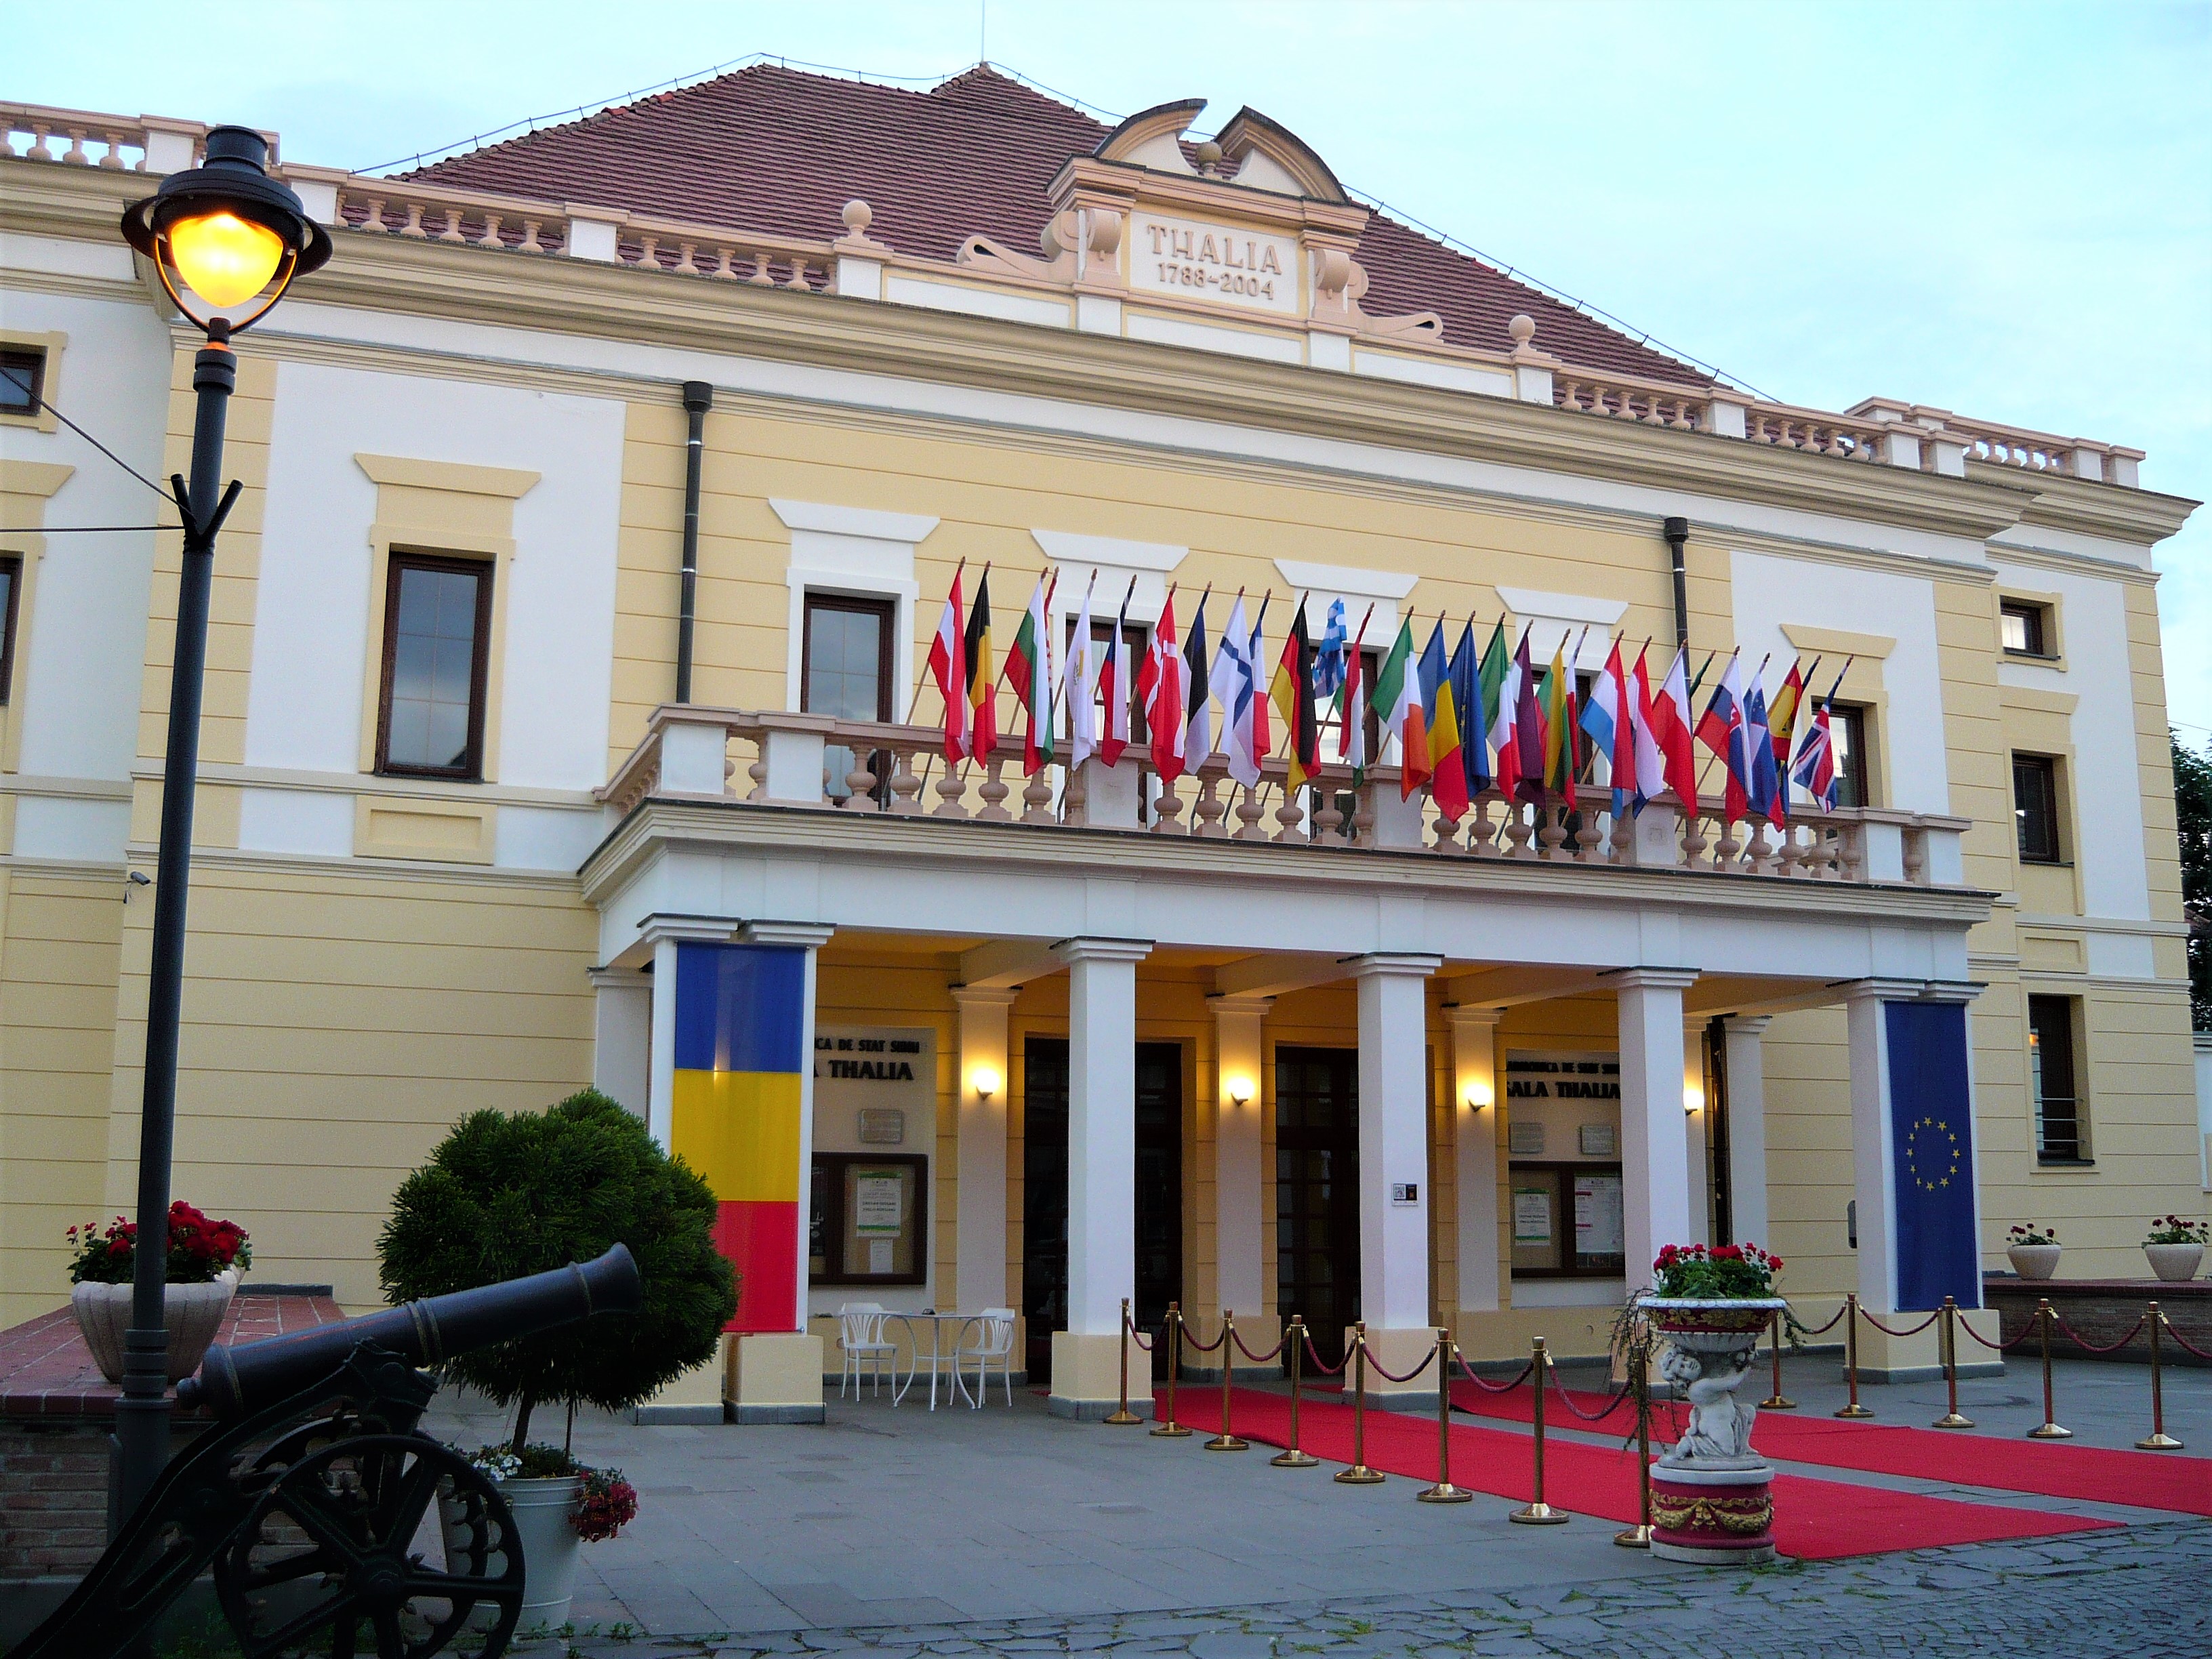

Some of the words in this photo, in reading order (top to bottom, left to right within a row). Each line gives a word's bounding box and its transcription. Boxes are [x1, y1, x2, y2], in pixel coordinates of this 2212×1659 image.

[1147, 224, 1282, 275] THALIA
[1158, 262, 1274, 300] 1788-2004
[838, 1039, 853, 1050] DE
[859, 1039, 886, 1052] STAT
[828, 1059, 914, 1080] THALIA
[1555, 1082, 1621, 1099] THALIA
